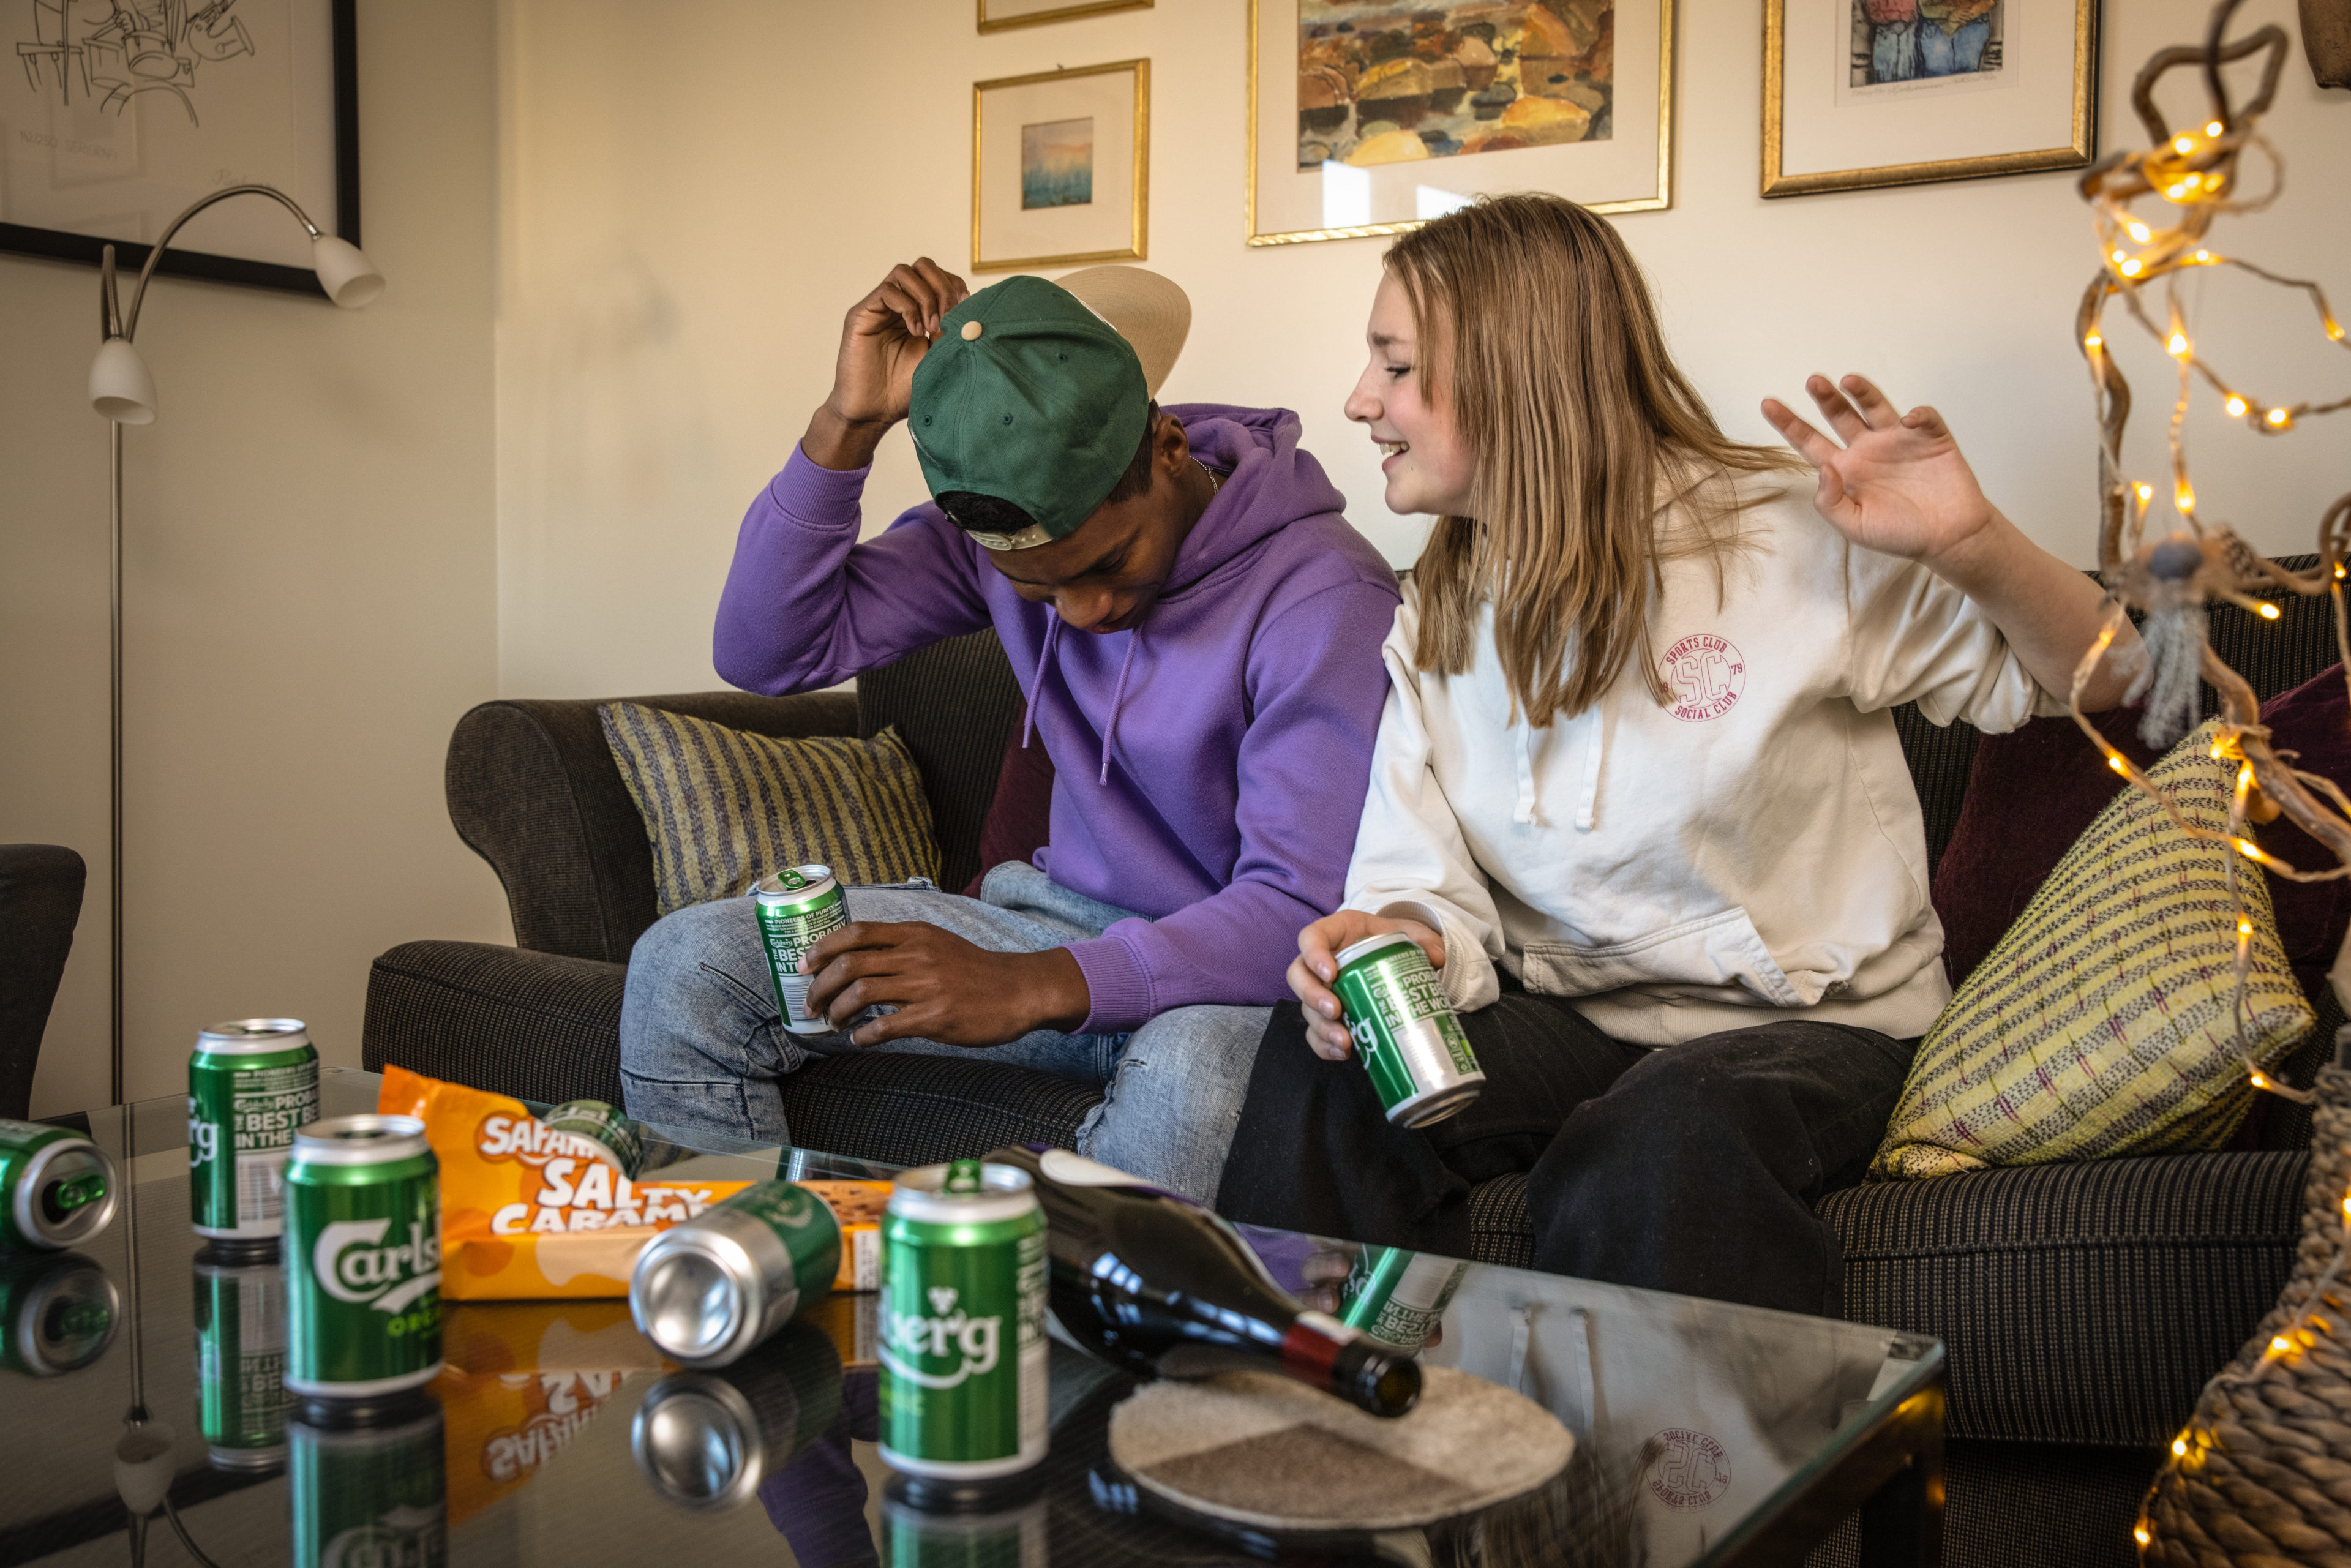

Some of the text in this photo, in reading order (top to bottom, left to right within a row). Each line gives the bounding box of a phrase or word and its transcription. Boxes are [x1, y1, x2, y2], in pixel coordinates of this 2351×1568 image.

[1666, 637, 1728, 665] SPORTS CLUB
[1674, 648, 1731, 708] SC
[1731, 663, 1743, 675] 79
[1674, 691, 1737, 720] SOCIAL CLUB
[774, 915, 805, 925] PIONEERS
[816, 904, 834, 917] PURITY
[778, 946, 812, 961] BES
[775, 961, 787, 972] IN
[1385, 1011, 1403, 1029] IN
[246, 1108, 301, 1132] BEST
[234, 1129, 293, 1149] IN THE
[536, 1157, 713, 1210] SALTY
